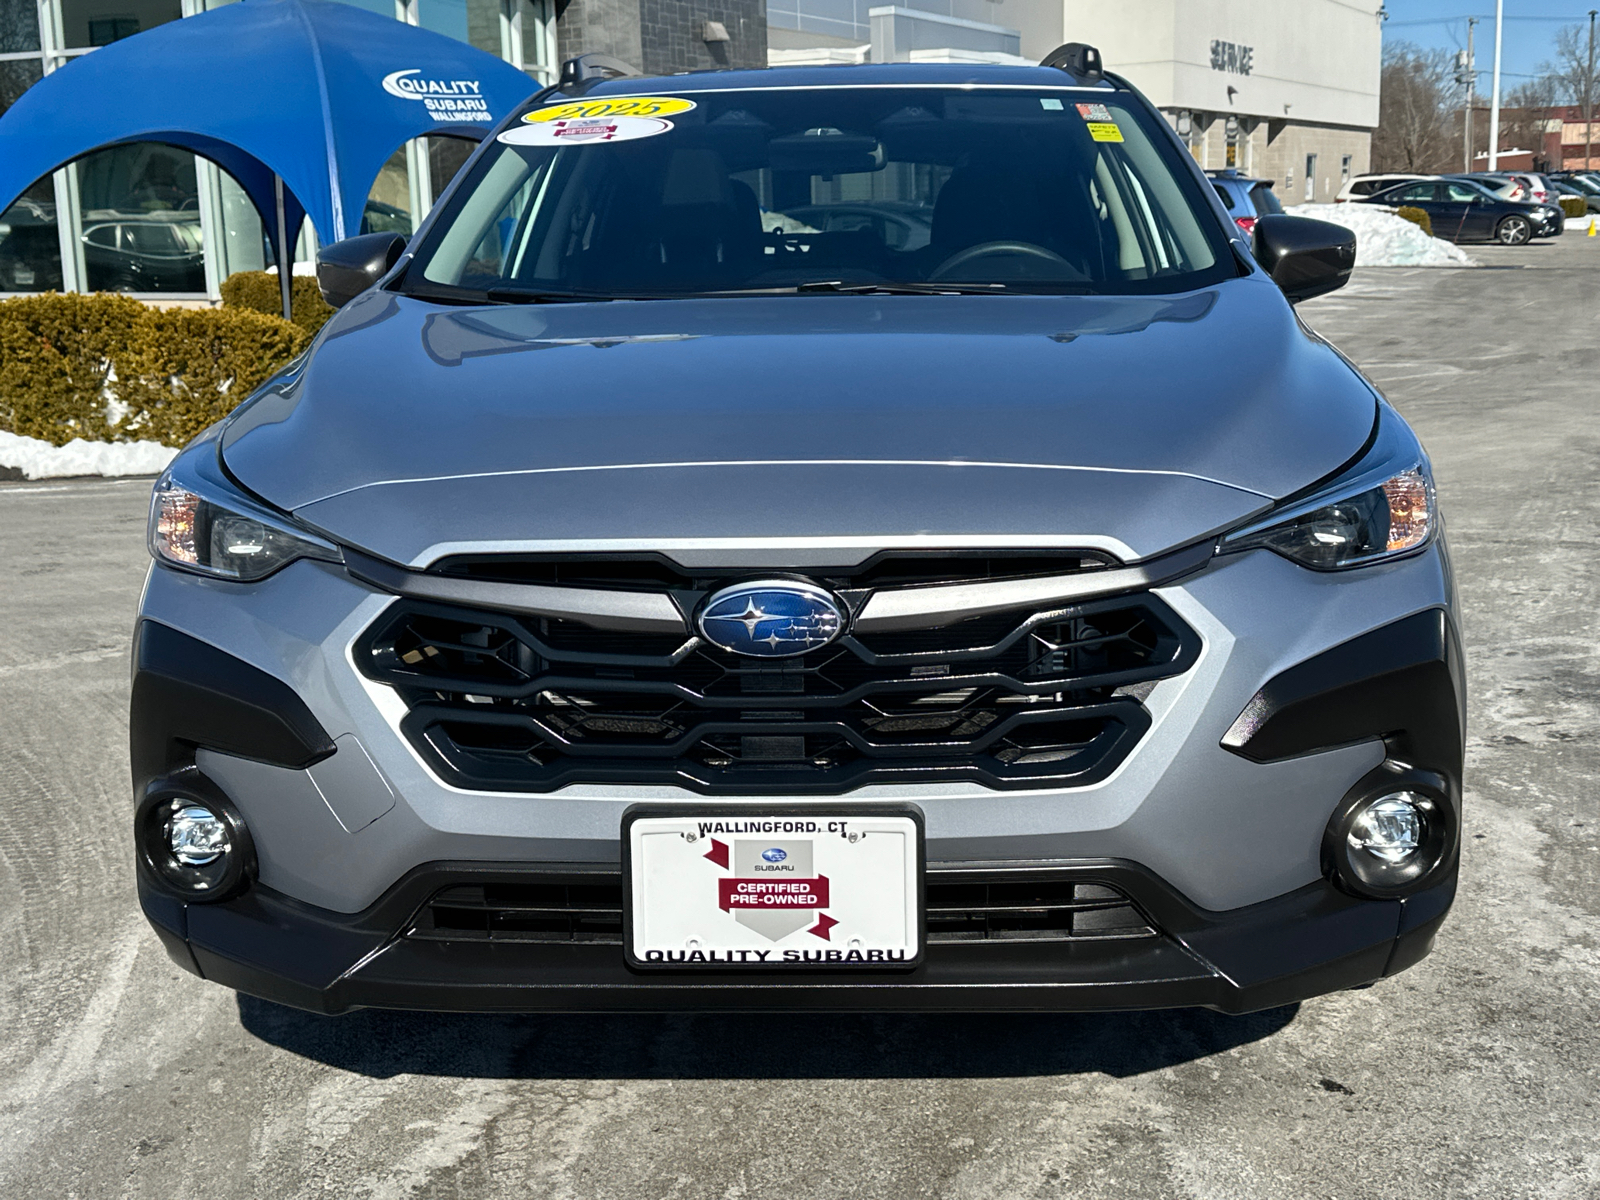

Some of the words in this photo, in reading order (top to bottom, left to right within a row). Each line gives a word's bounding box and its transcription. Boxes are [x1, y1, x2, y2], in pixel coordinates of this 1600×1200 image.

[399, 78, 480, 94] QUALITY
[424, 98, 488, 111] SUBARU
[428, 111, 493, 122] WALLINGFORD
[548, 101, 671, 121] 2025
[698, 822, 821, 834] WALLINGFORD,
[827, 822, 848, 833] CT
[737, 883, 810, 893] CERTIFIED
[730, 894, 818, 904] PRE-OWNED
[645, 949, 772, 963] QUALITY
[783, 949, 905, 962] SUBARU
